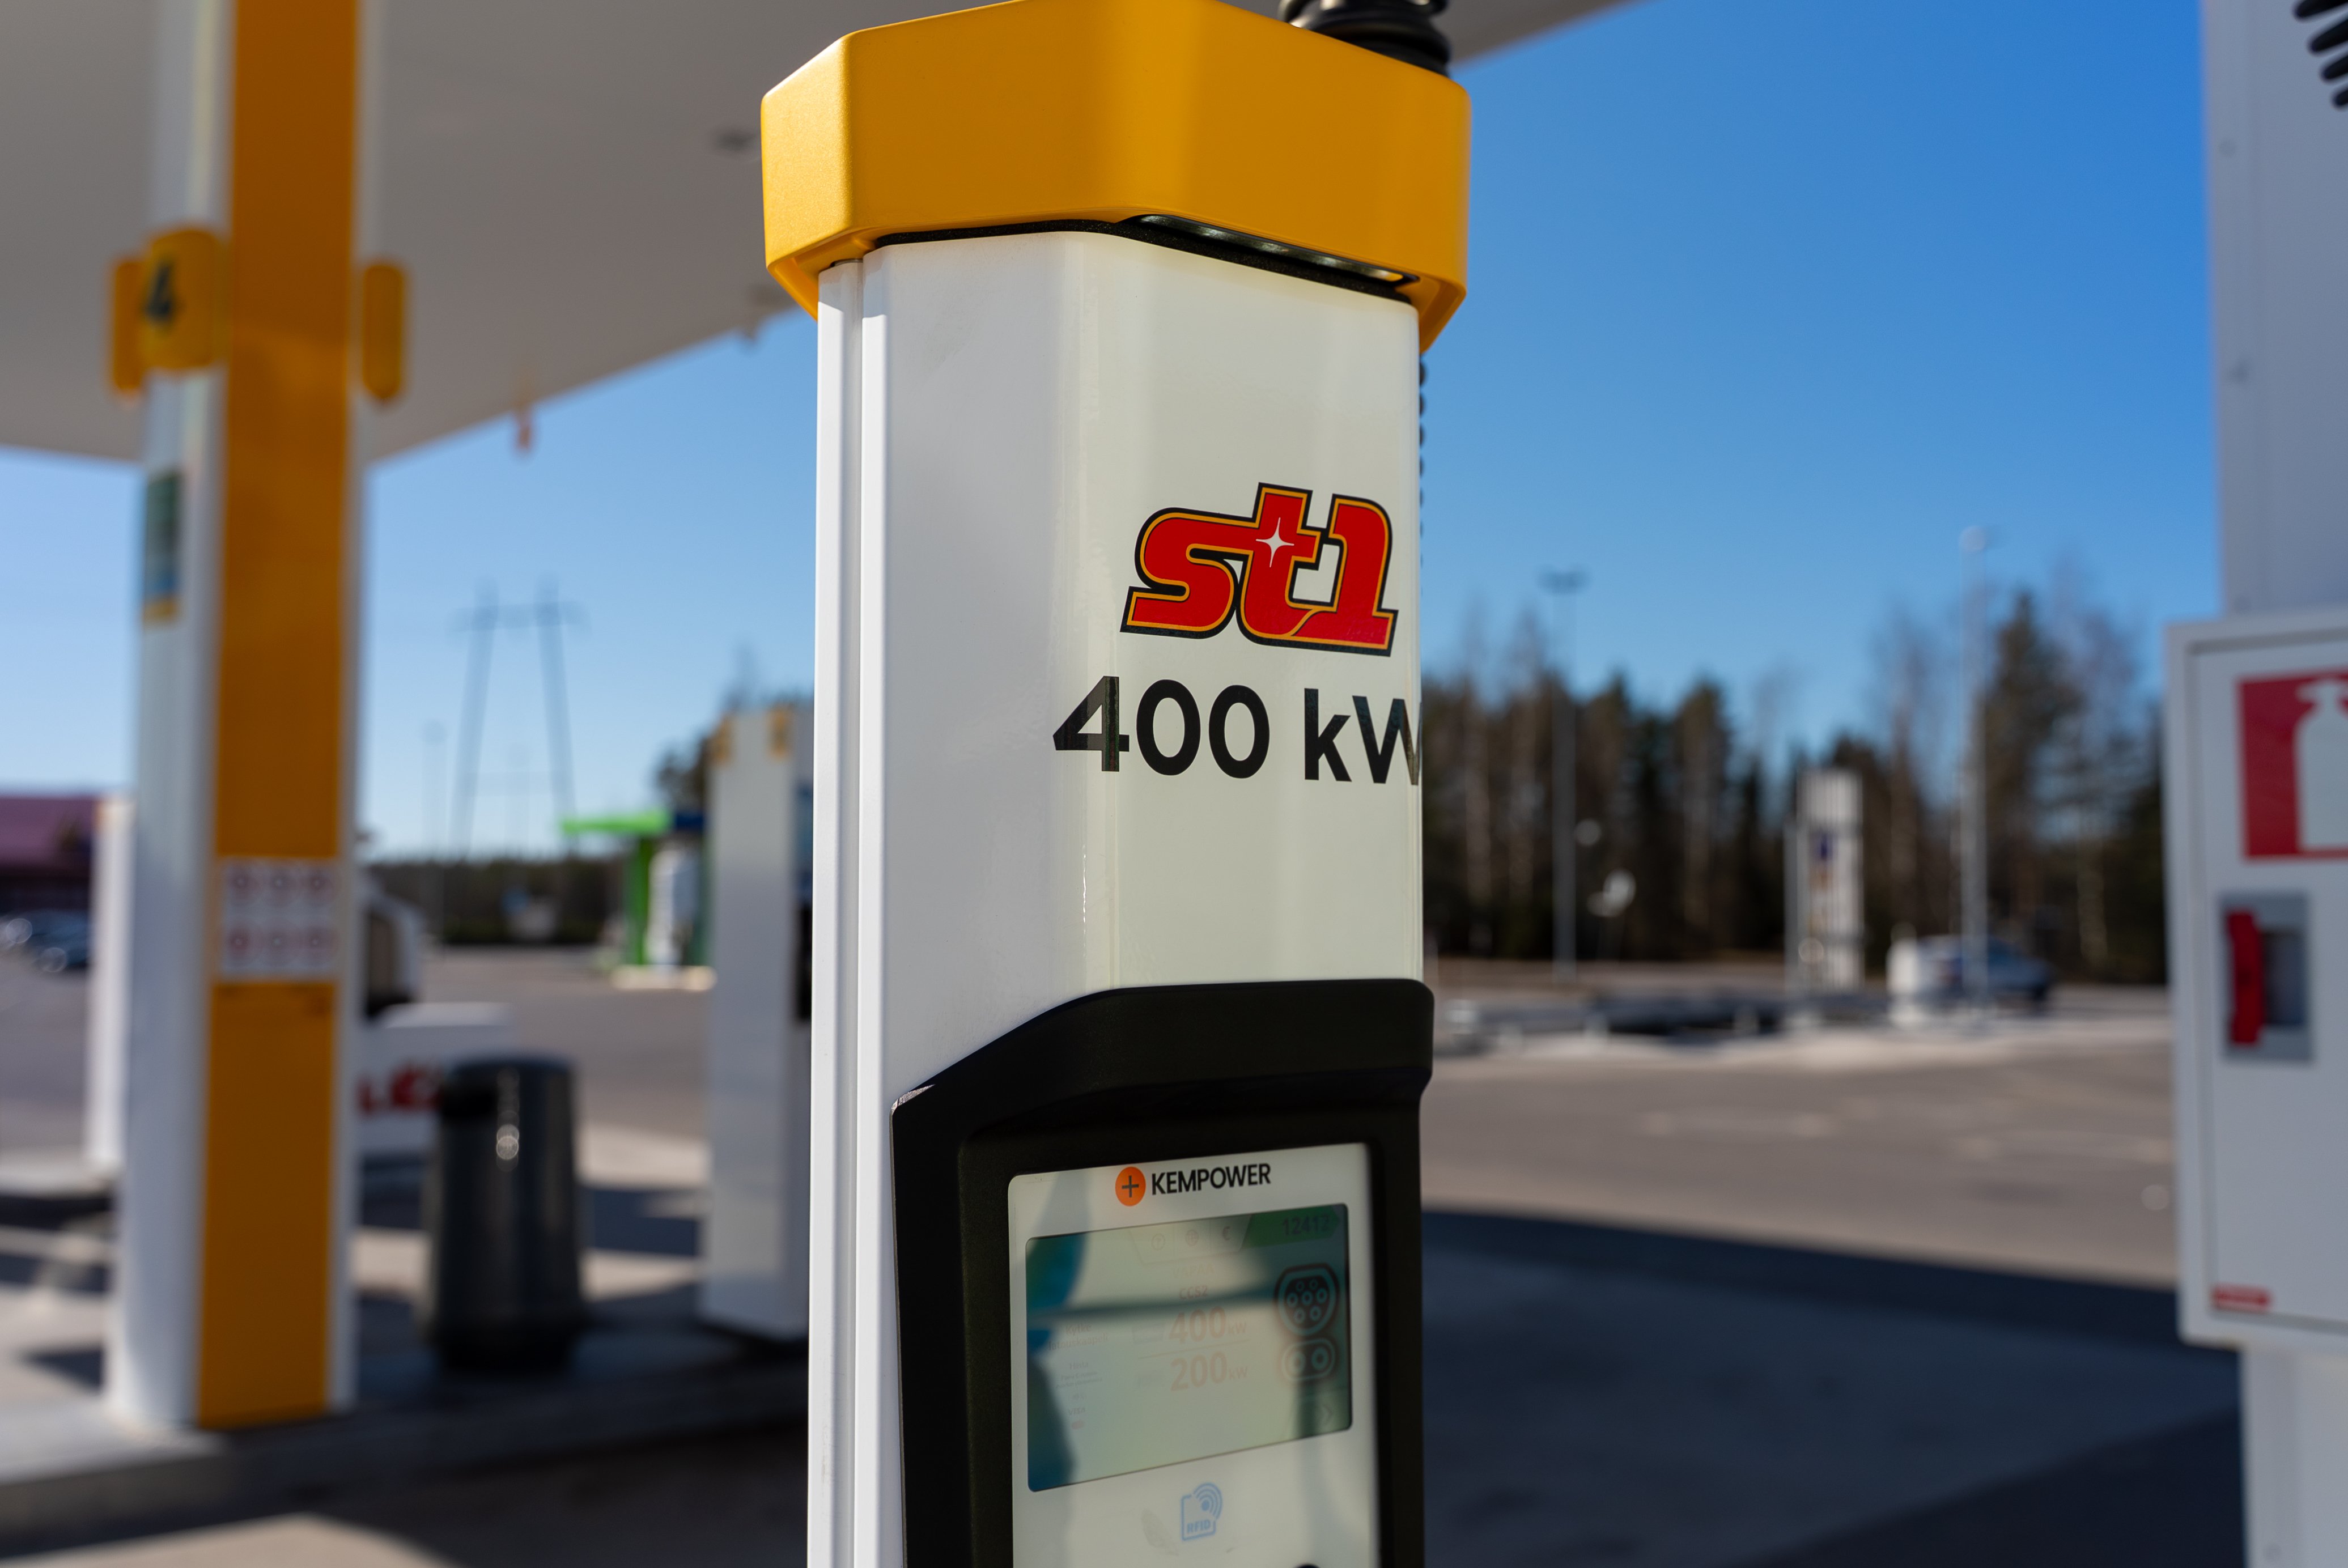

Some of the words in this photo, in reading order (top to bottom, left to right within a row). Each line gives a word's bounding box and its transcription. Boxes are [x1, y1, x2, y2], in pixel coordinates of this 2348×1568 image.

[1052, 675, 1269, 779] 400
[1304, 687, 1421, 785] kW
[1151, 1163, 1271, 1196] KEMPOWER
[1179, 1285, 1208, 1299] CCS2
[1186, 1519, 1211, 1535] RFID
